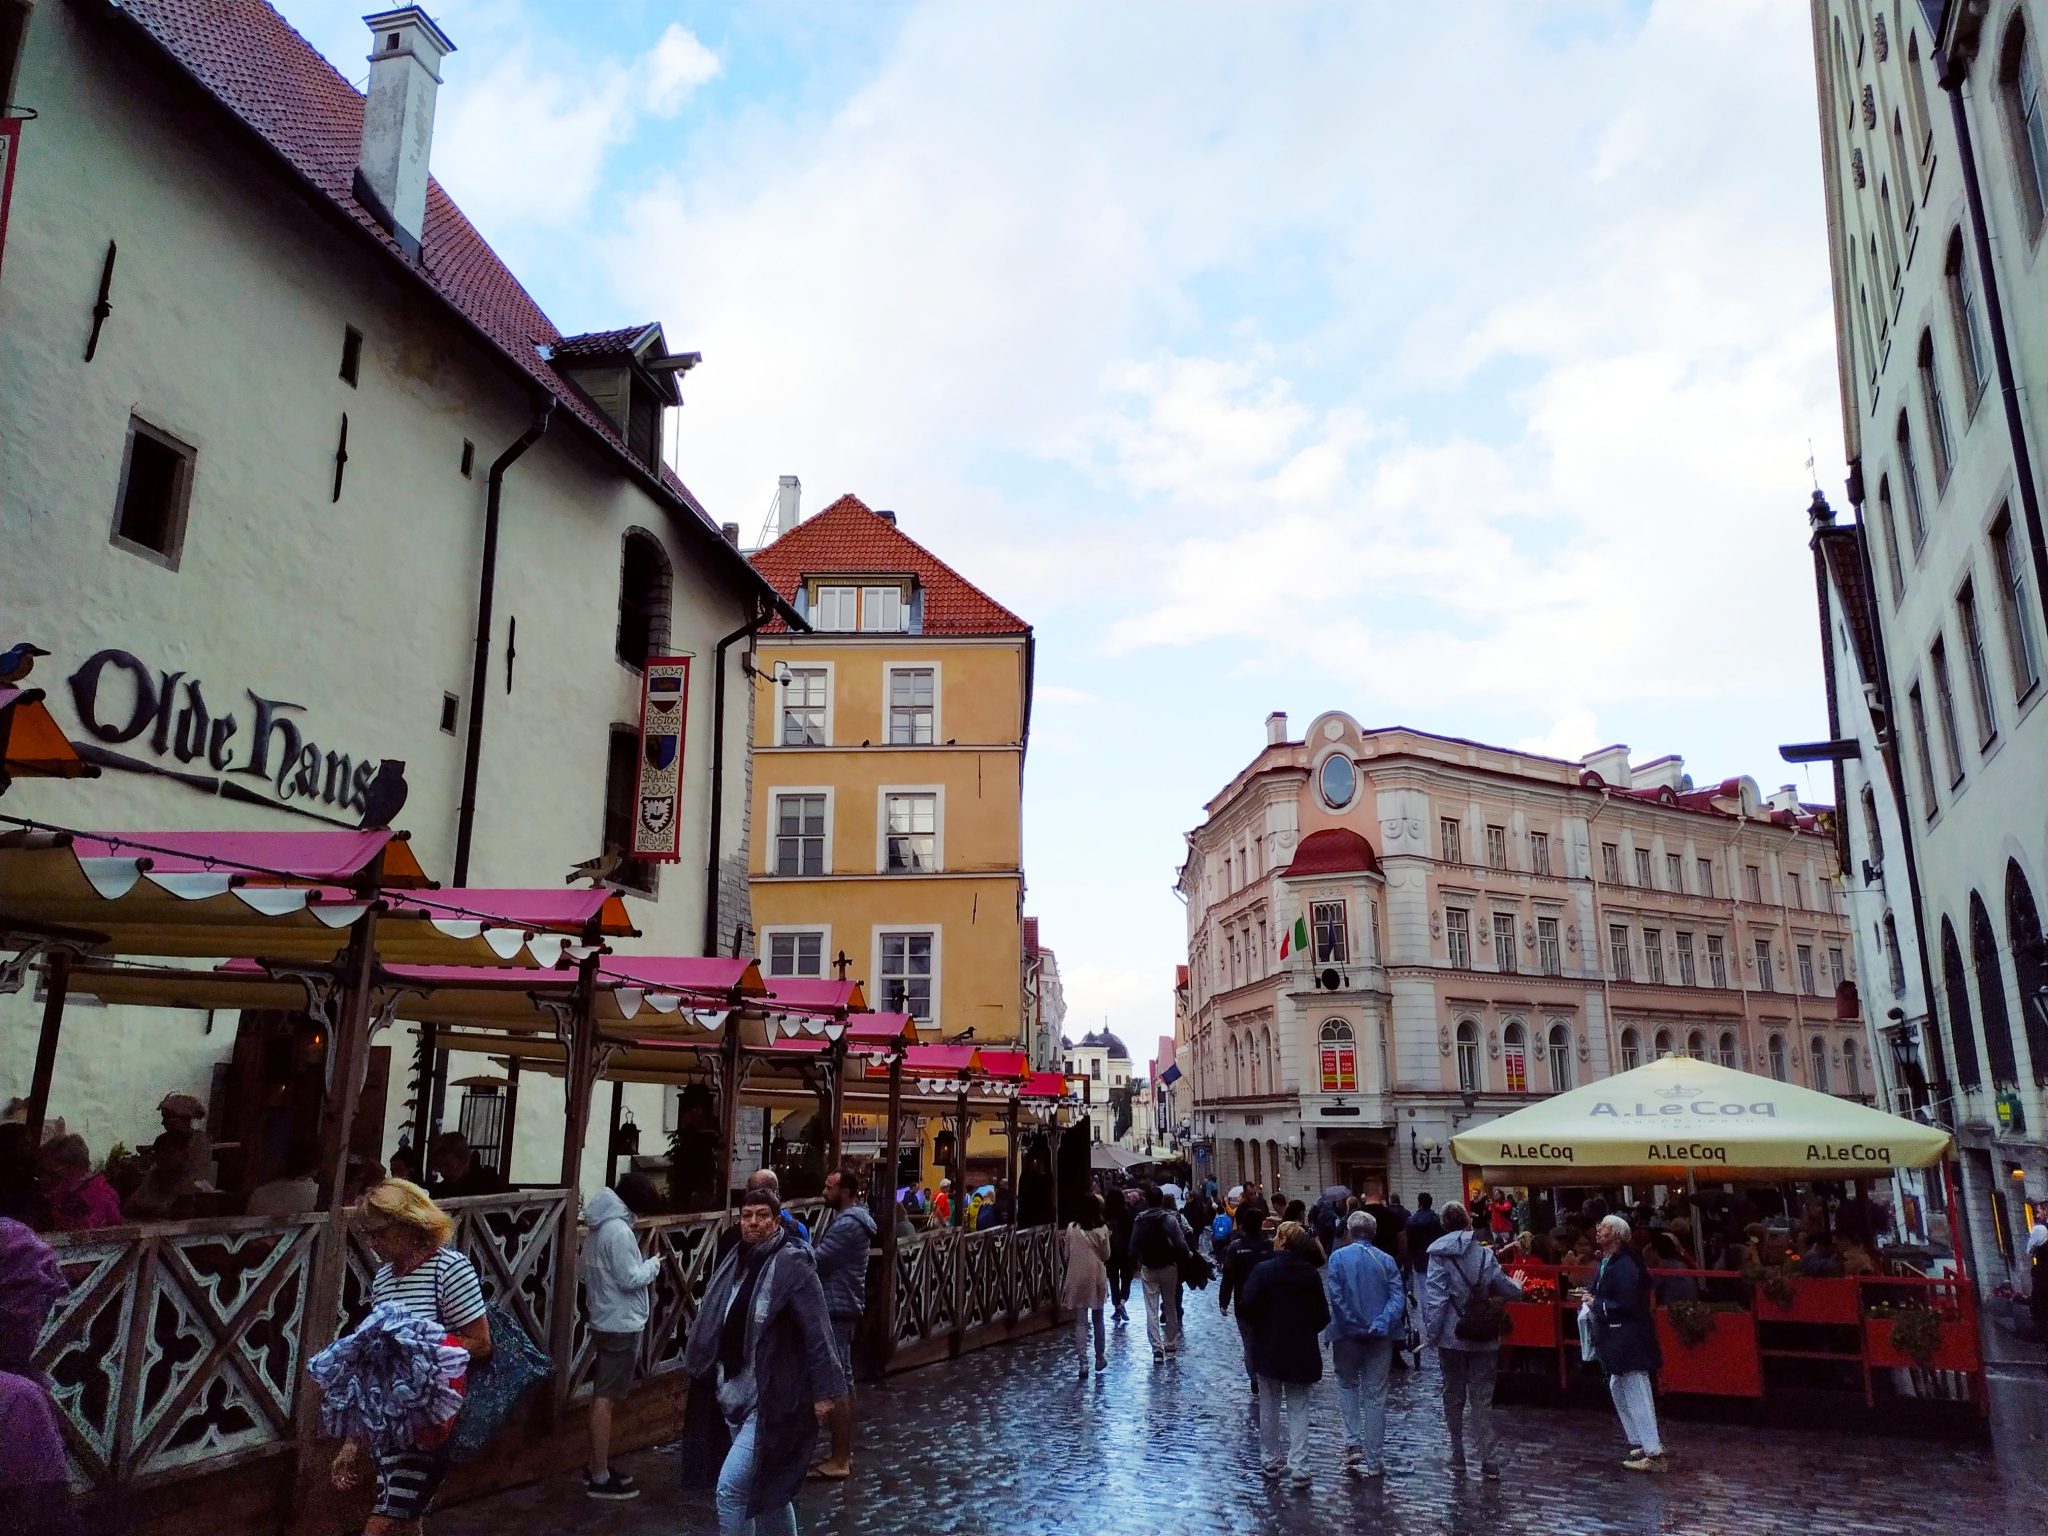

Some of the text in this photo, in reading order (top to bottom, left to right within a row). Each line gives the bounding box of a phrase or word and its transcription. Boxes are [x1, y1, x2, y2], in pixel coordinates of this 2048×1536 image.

[68, 649, 238, 771] Olde
[646, 715, 681, 726] ROSTOCK
[638, 835, 673, 846] WISMAR
[841, 1114, 867, 1126] altic
[899, 1148, 912, 1156] AR
